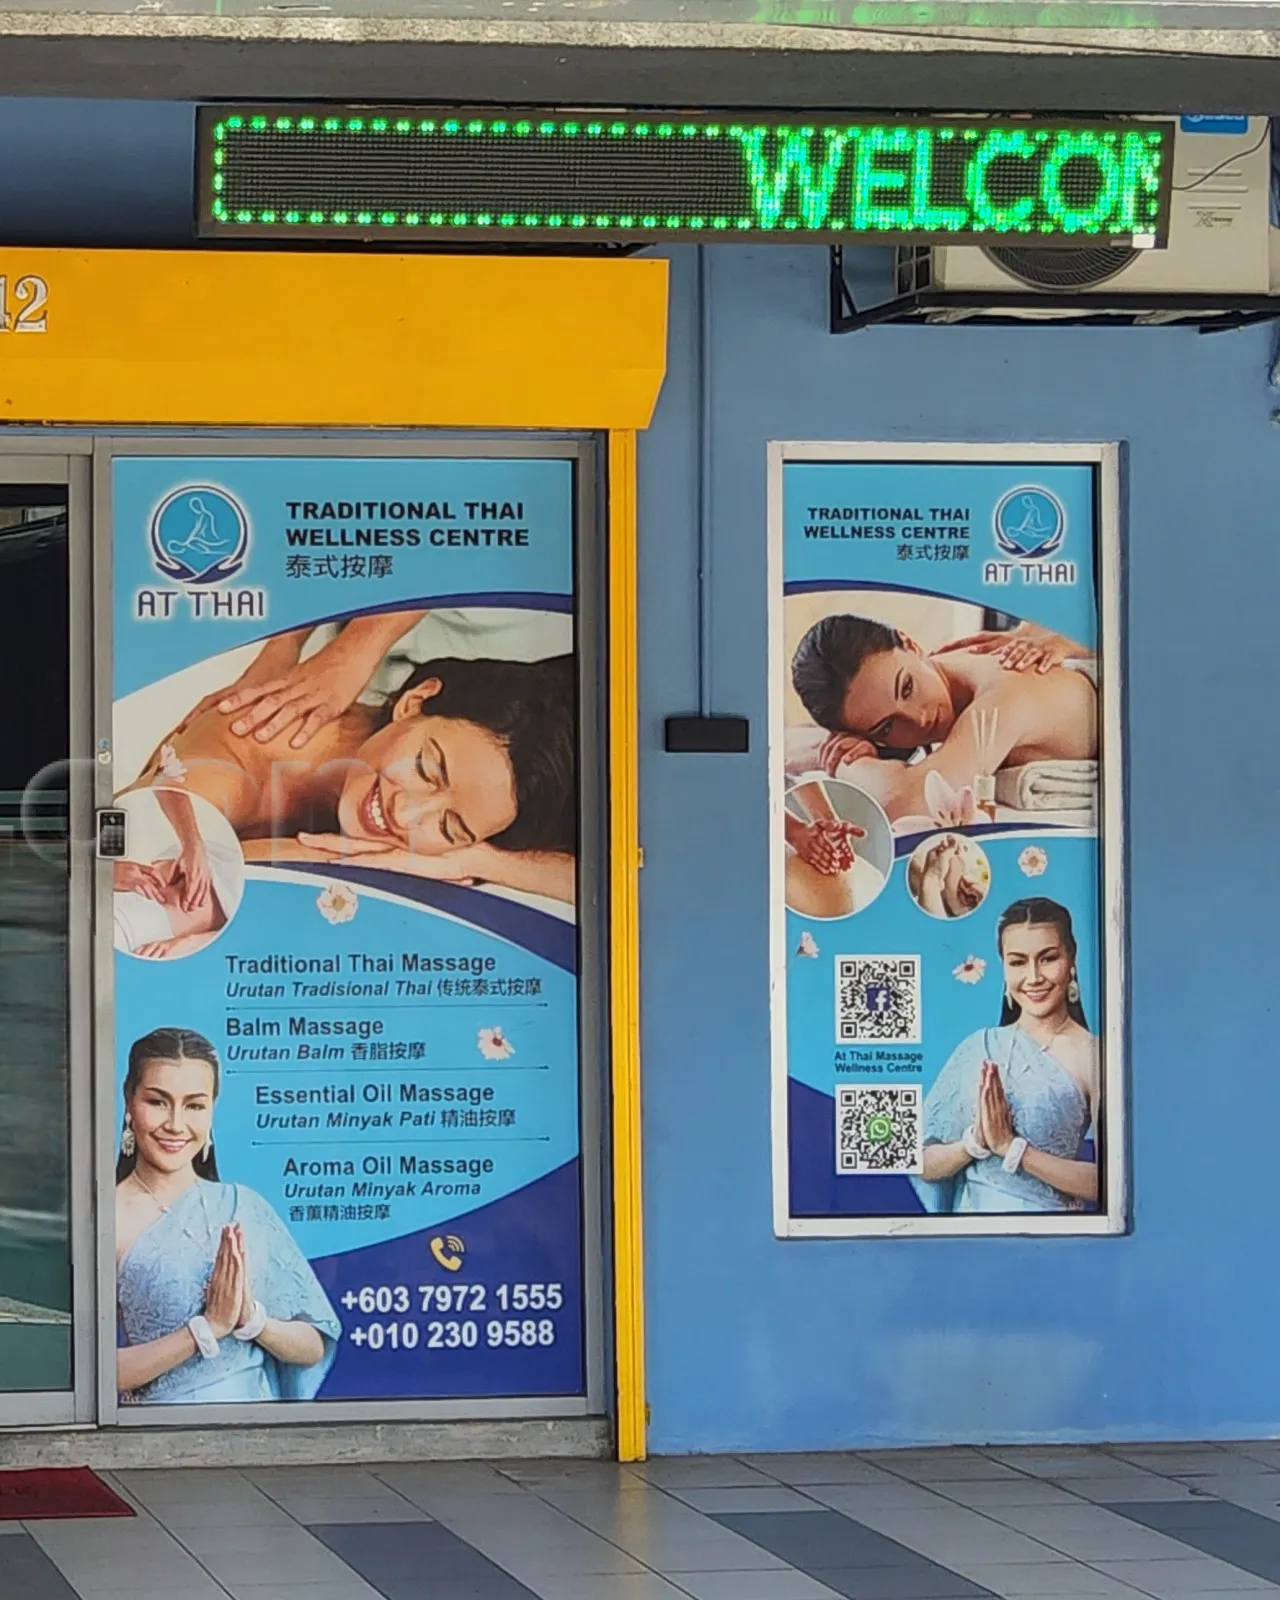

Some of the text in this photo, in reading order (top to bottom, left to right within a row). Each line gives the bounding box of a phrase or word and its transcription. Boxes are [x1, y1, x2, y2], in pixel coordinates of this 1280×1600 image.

[287, 501, 524, 521] TRADITIONAL THAI
[807, 507, 970, 521] TRADITIONAL THAI
[285, 528, 529, 547] WELLNESS CENTRE
[804, 526, 970, 540] WELLNESS CENTRE
[896, 544, 970, 562] 泰式按摩
[285, 553, 394, 579] 泰式按摩
[984, 563, 1076, 583] AT THAI
[137, 590, 264, 617] AT THAI
[226, 953, 496, 975] Traditional Thai Massage
[226, 977, 543, 998] Urutan Tradisional Thai 传统泰式按摩
[226, 1017, 384, 1038] Balm Massage
[226, 1042, 426, 1061] Urutan Balm 香脂按摩
[835, 1051, 923, 1063] At Thai Massage
[835, 1062, 923, 1073] Wellness Centre
[256, 1084, 494, 1105] Essential Oil Massage
[256, 1109, 516, 1130] Urutan Minyak Pati 精油按摩
[283, 1156, 494, 1177] Aroma Oil Massage
[284, 1181, 481, 1200] Urutan Minyak Aroma
[341, 1283, 562, 1313] +603 7972 1555
[350, 1320, 554, 1349] +010 230 9588
